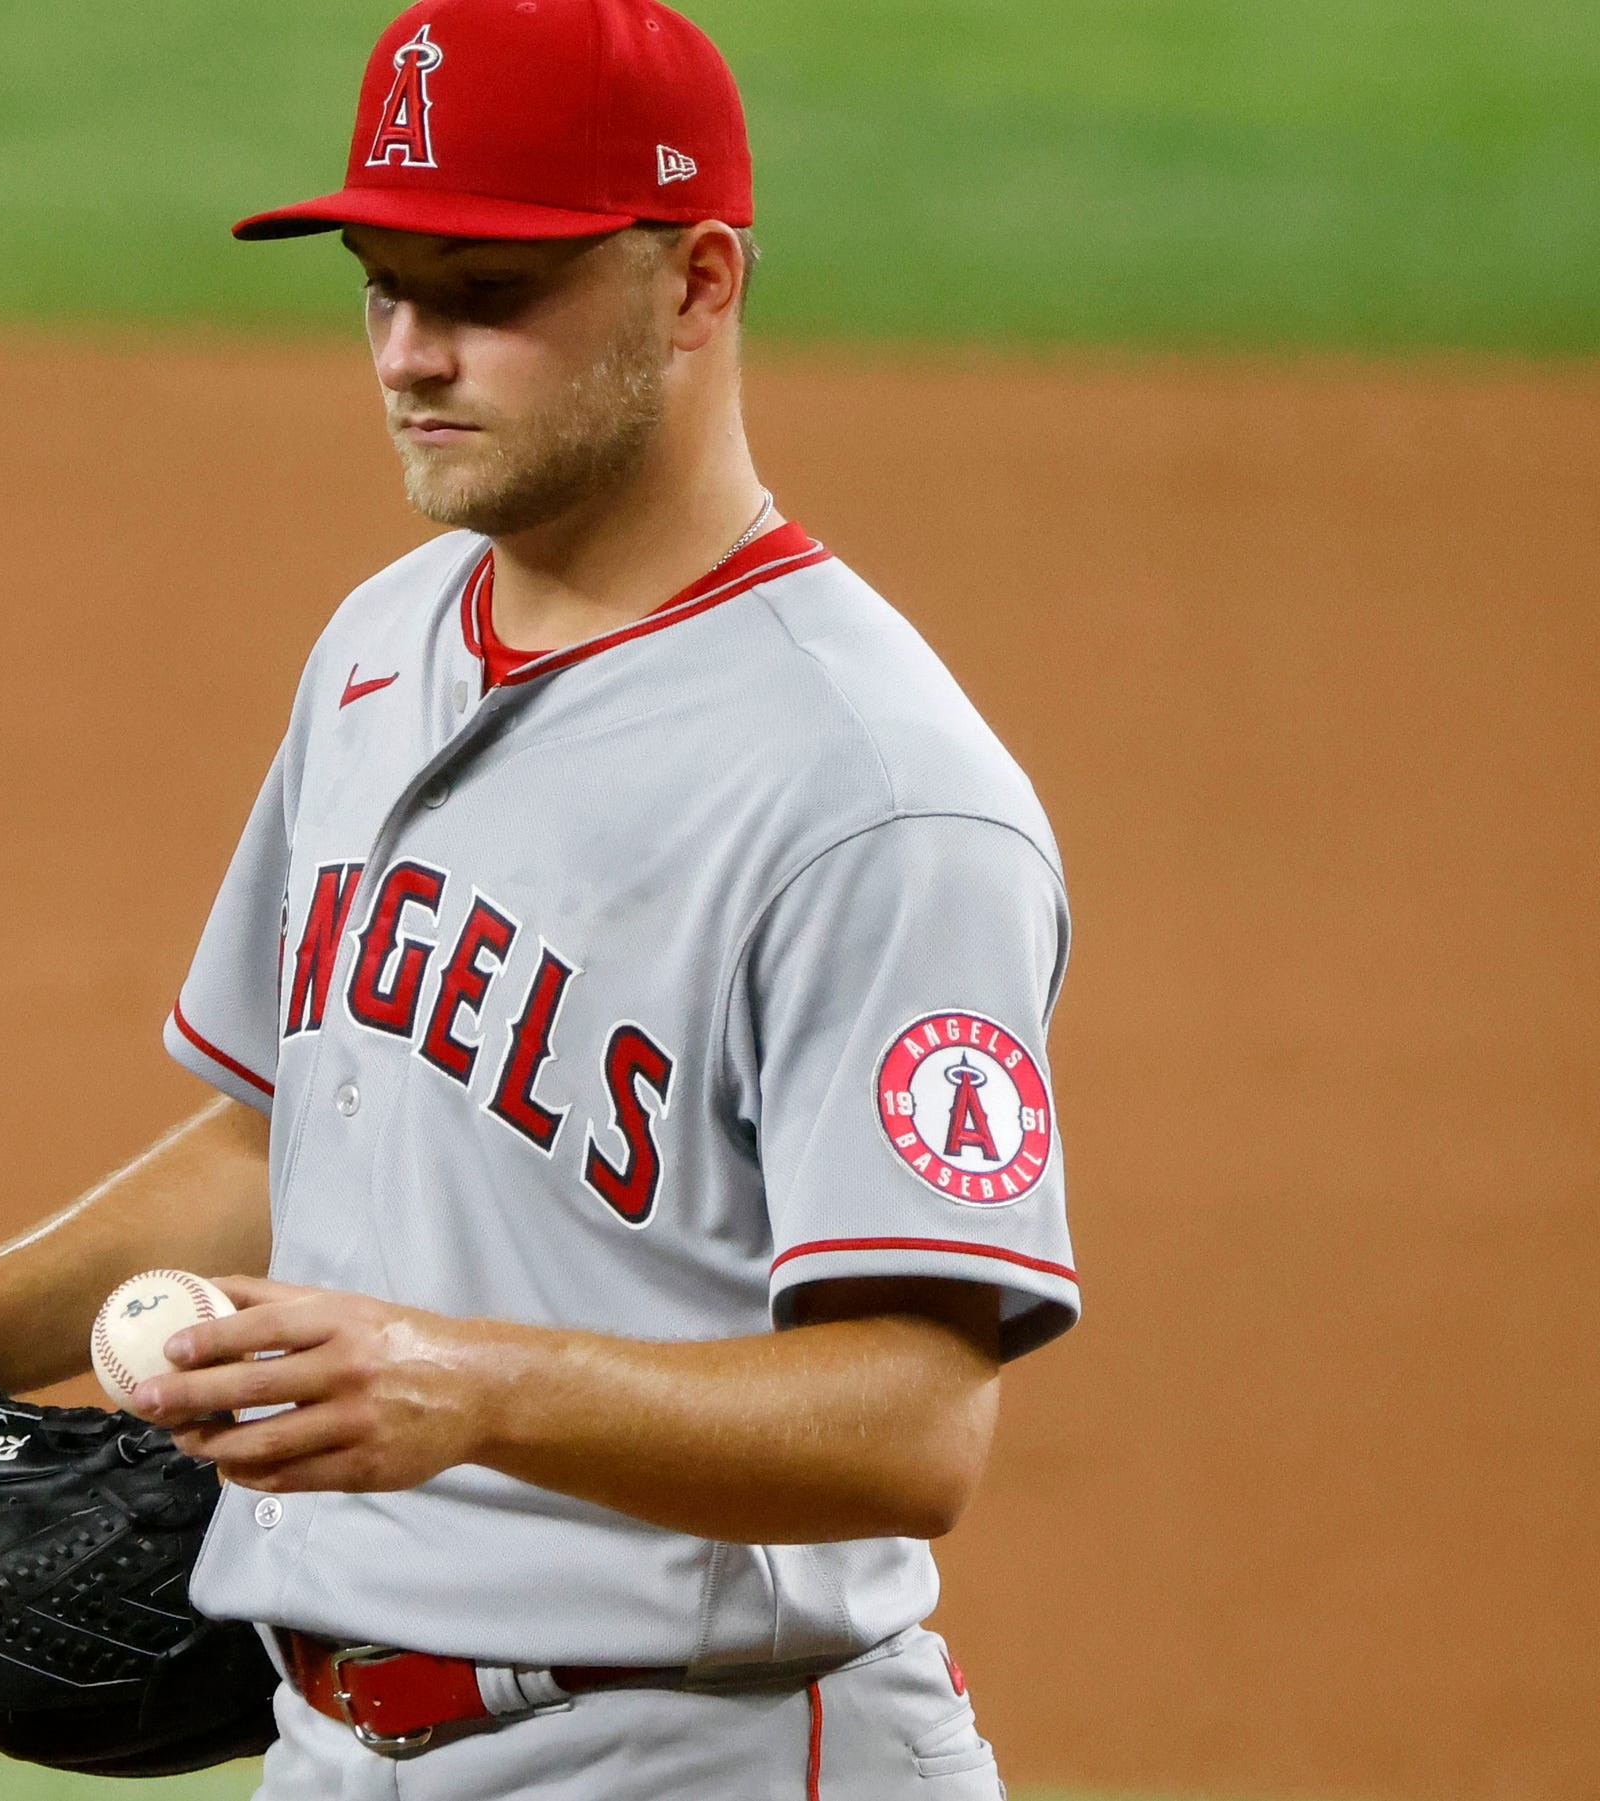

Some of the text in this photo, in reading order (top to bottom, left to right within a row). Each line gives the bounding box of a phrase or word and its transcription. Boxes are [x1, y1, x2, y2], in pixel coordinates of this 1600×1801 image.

[365, 24, 443, 168] A
[278, 855, 678, 1230] NGELS
[903, 1018, 1023, 1069] ANGELS
[943, 1050, 1001, 1162] A
[895, 1131, 1043, 1199] BASEBALL
